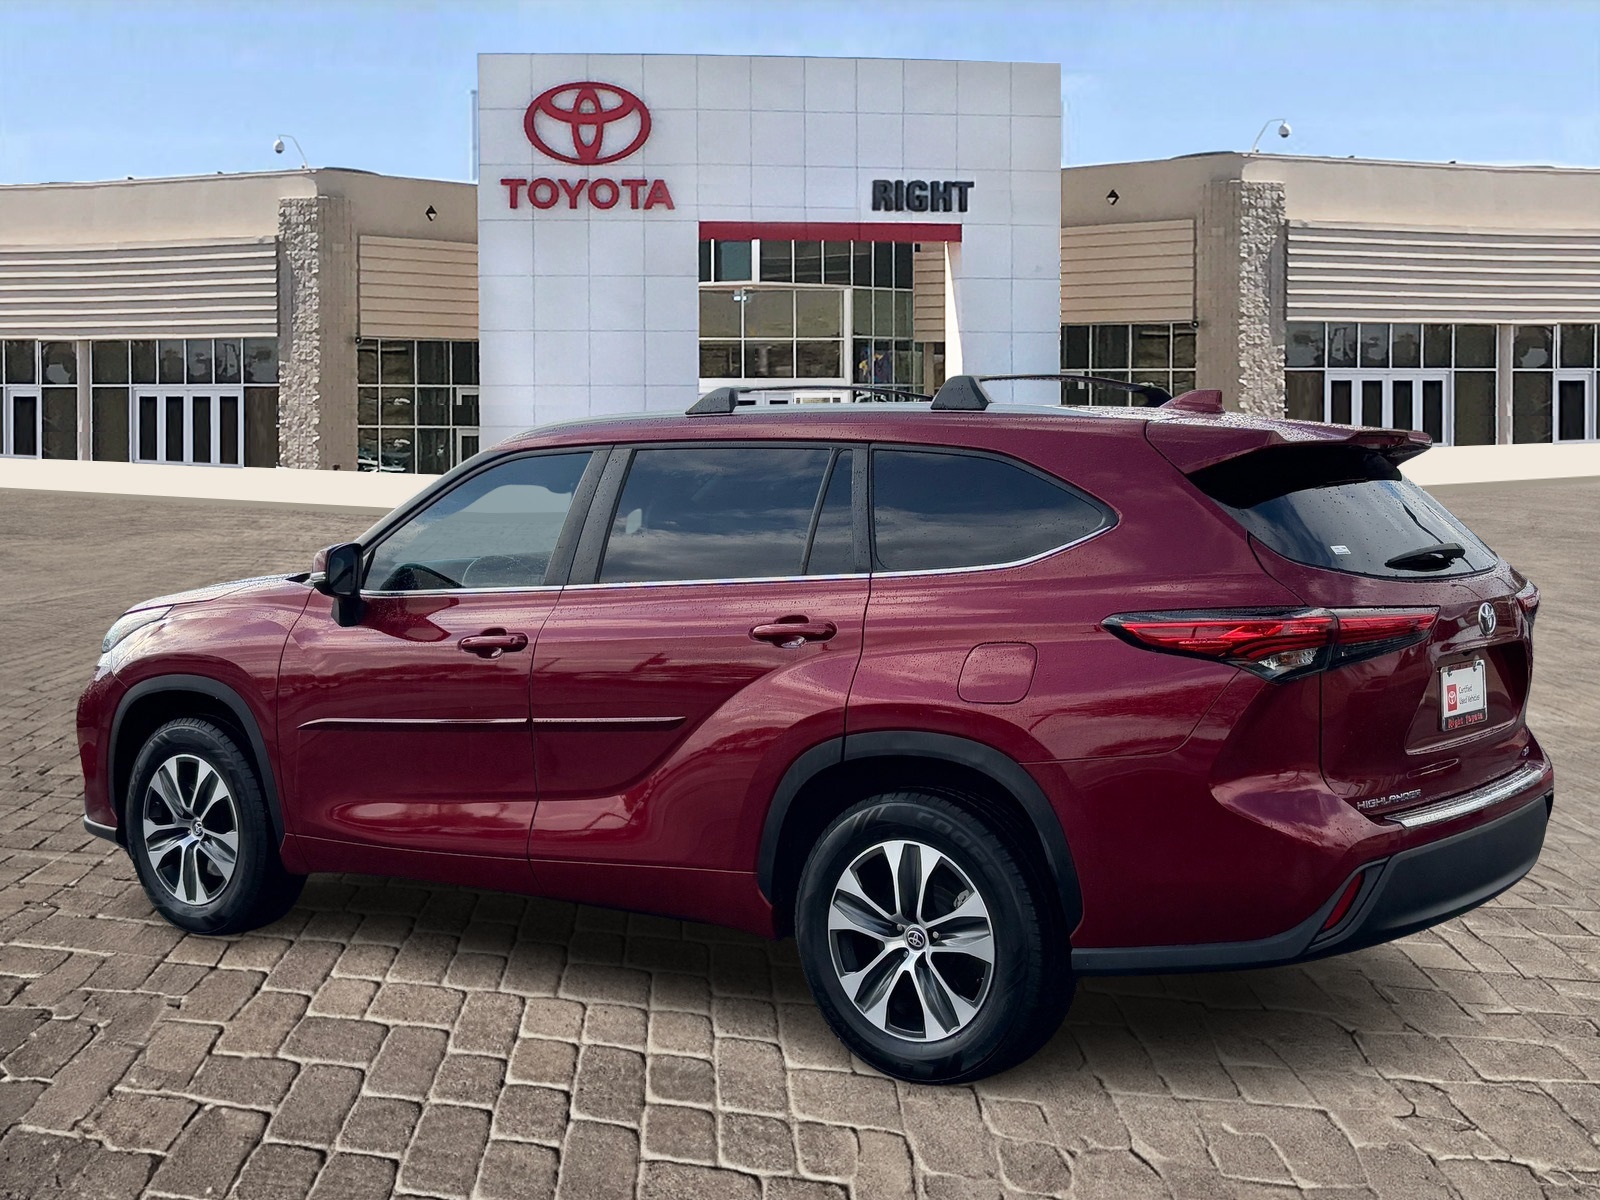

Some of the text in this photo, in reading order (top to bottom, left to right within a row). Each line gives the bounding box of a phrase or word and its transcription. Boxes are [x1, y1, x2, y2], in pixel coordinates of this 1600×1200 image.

[501, 178, 675, 210] TOYOTA
[872, 180, 975, 213] RIGHT
[1357, 789, 1421, 810] HIGHLANDER
